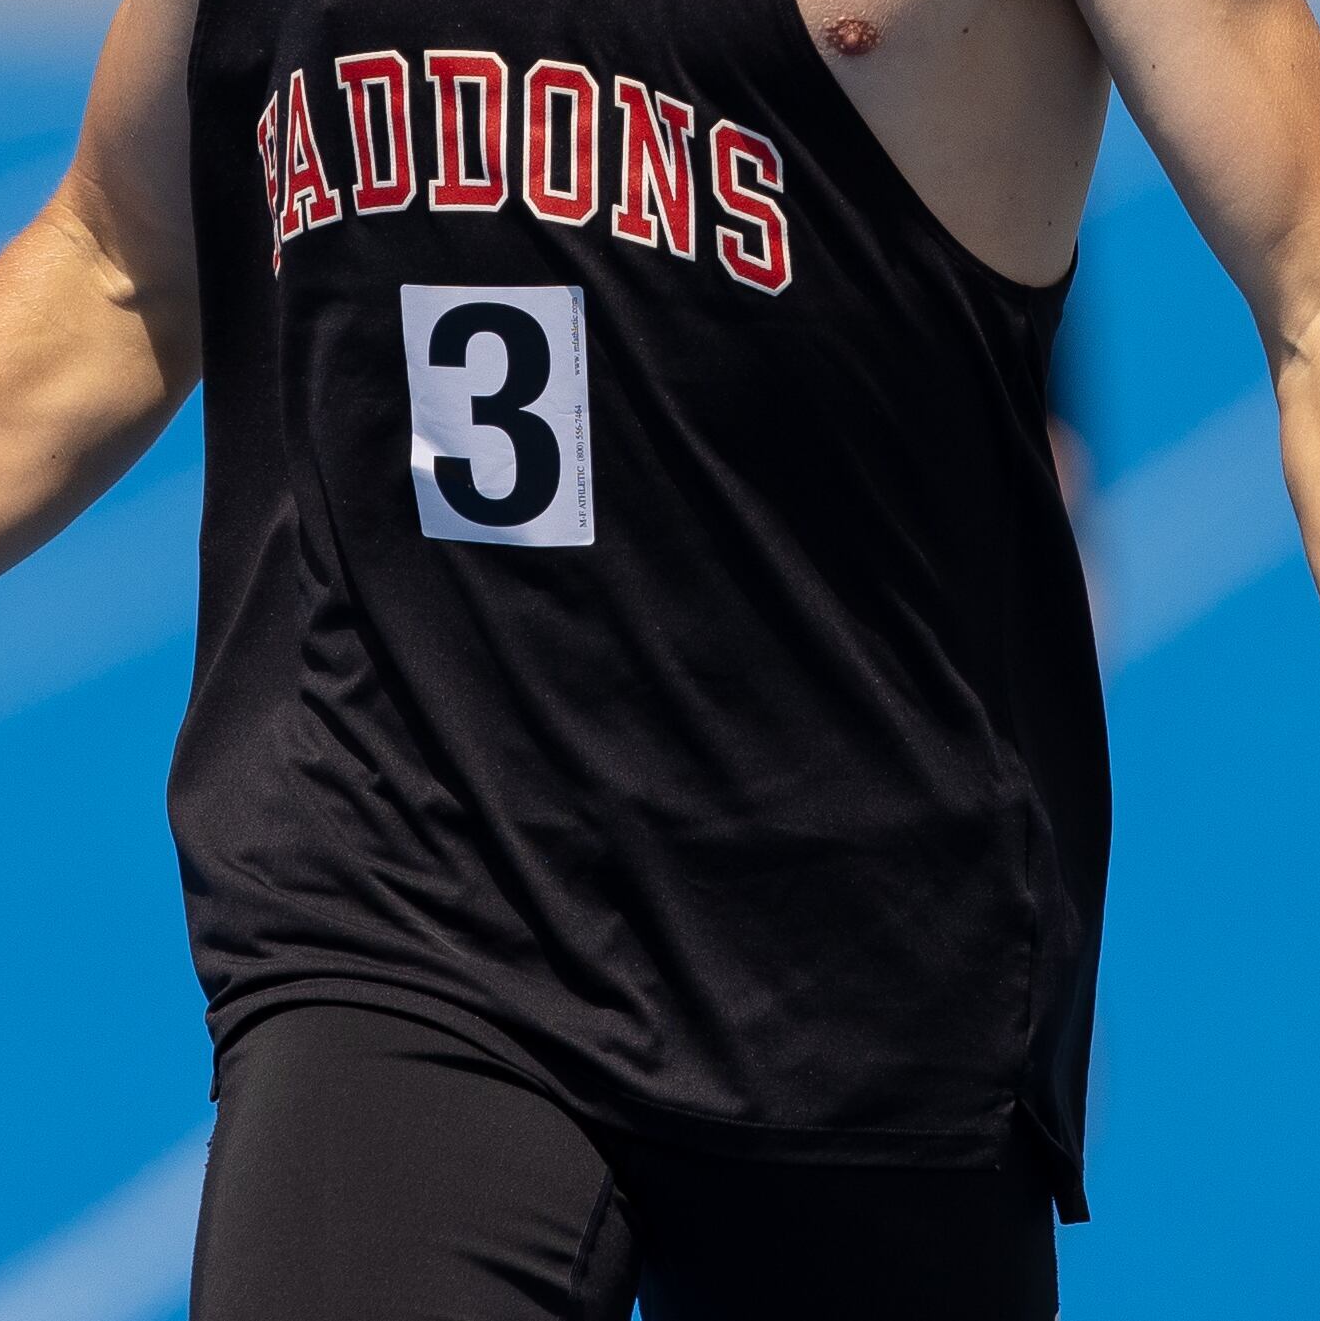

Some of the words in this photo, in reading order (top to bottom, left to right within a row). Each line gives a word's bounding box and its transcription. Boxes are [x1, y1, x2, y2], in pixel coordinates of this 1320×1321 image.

[428, 302, 561, 527] 3
[574, 405, 584, 440] 556-7464
[575, 441, 585, 462] (800)
[577, 466, 587, 509] ATHLETIC
